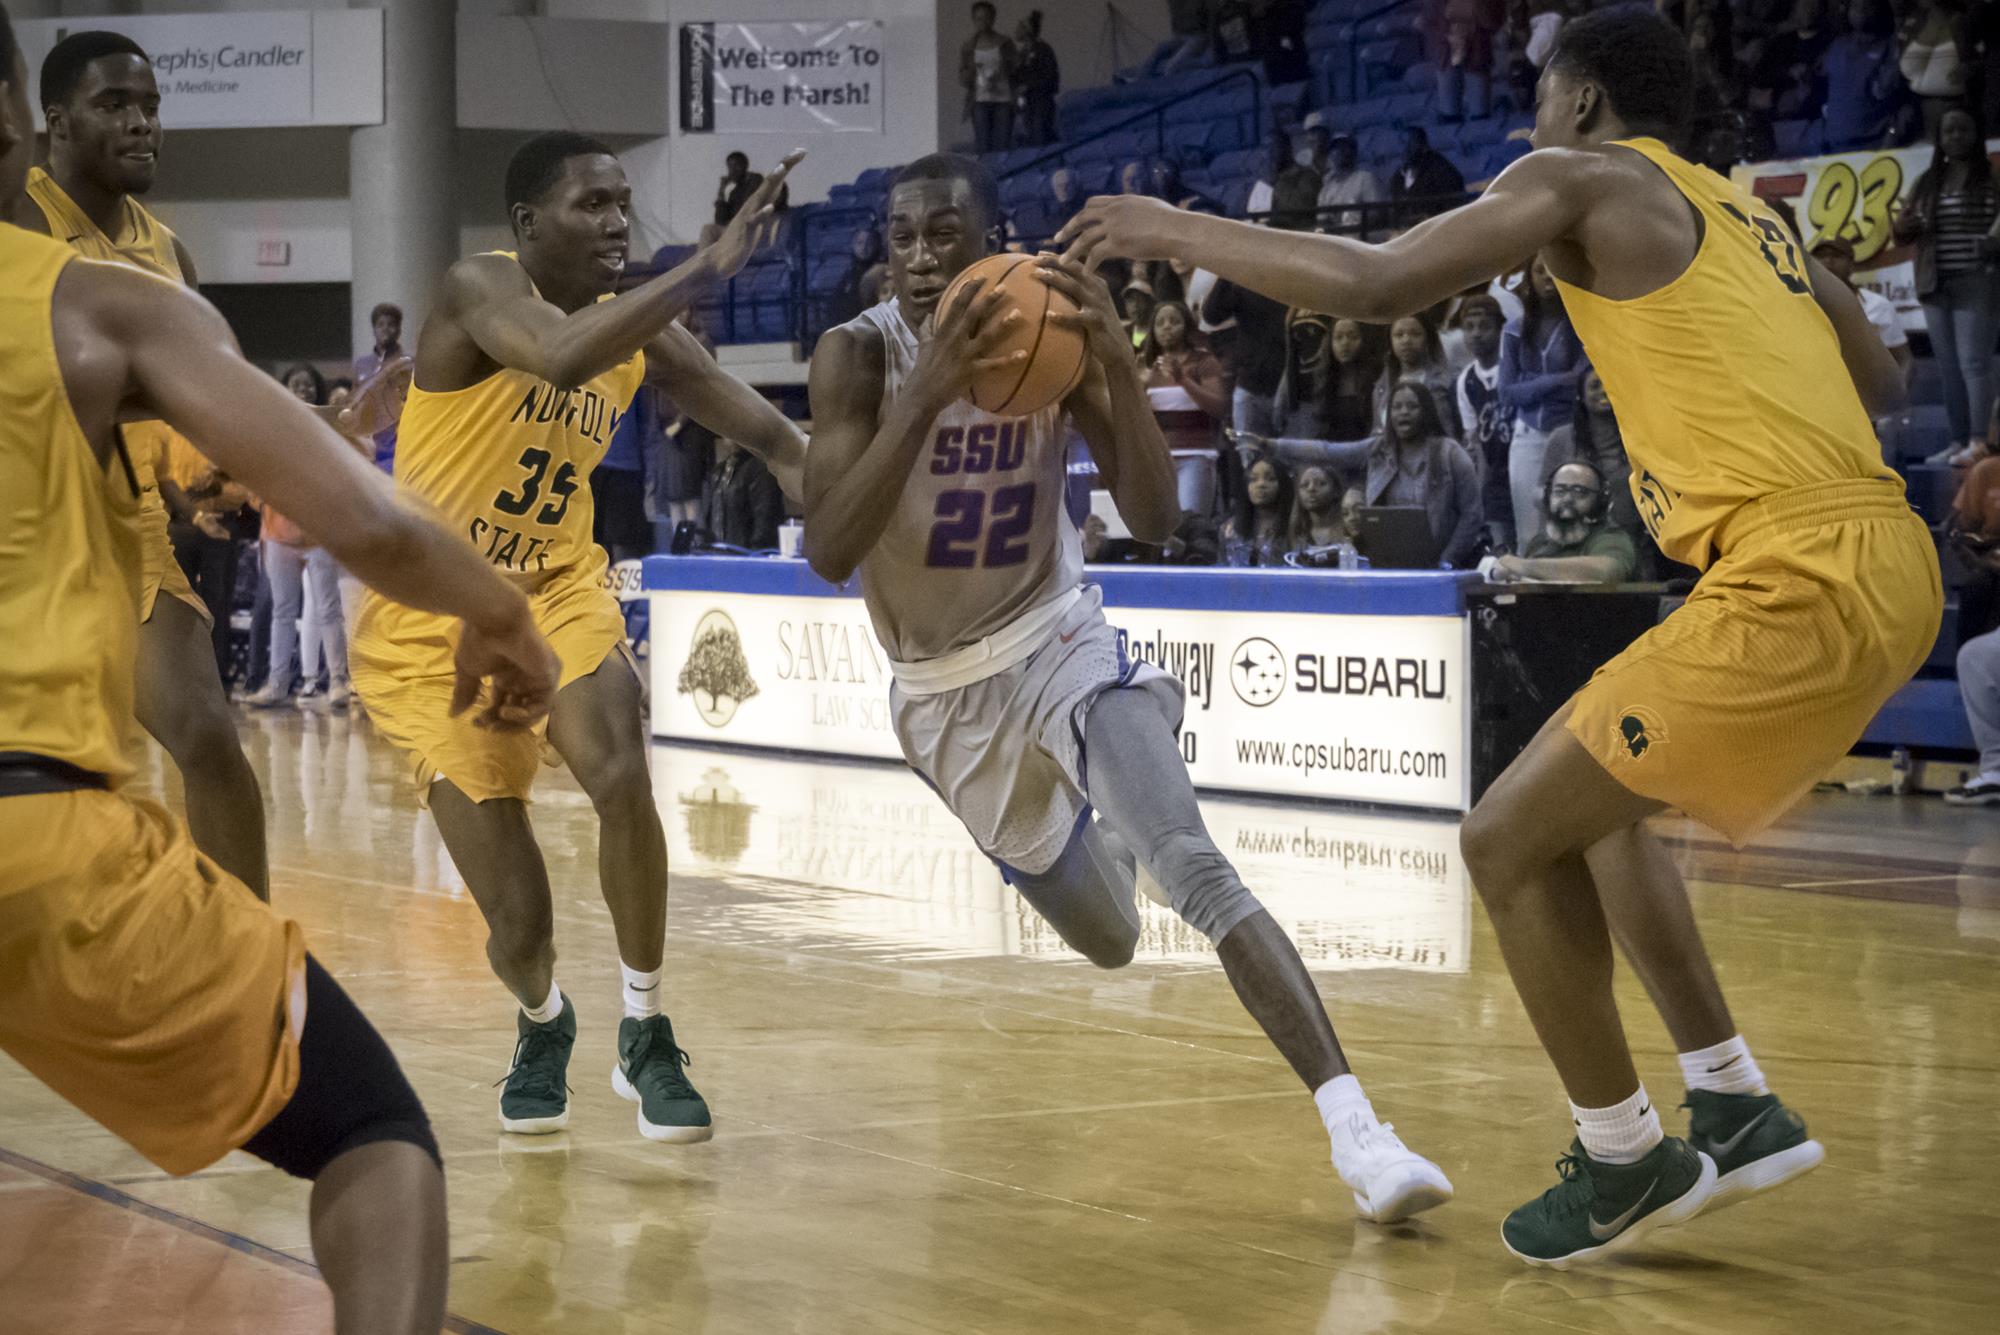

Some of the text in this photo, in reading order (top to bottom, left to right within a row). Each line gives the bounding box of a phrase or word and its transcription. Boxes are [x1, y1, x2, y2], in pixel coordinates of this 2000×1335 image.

[718, 44, 880, 68] Welcome To
[174, 80, 240, 94] Medicine
[730, 84, 775, 107] The
[930, 420, 1028, 476] SSU
[493, 447, 580, 526] 35
[926, 482, 1037, 569] 22
[777, 620, 882, 683] SAVAN
[1295, 653, 1447, 699] SUBARU
[1236, 737, 1447, 778] www.cpsubaru.com
